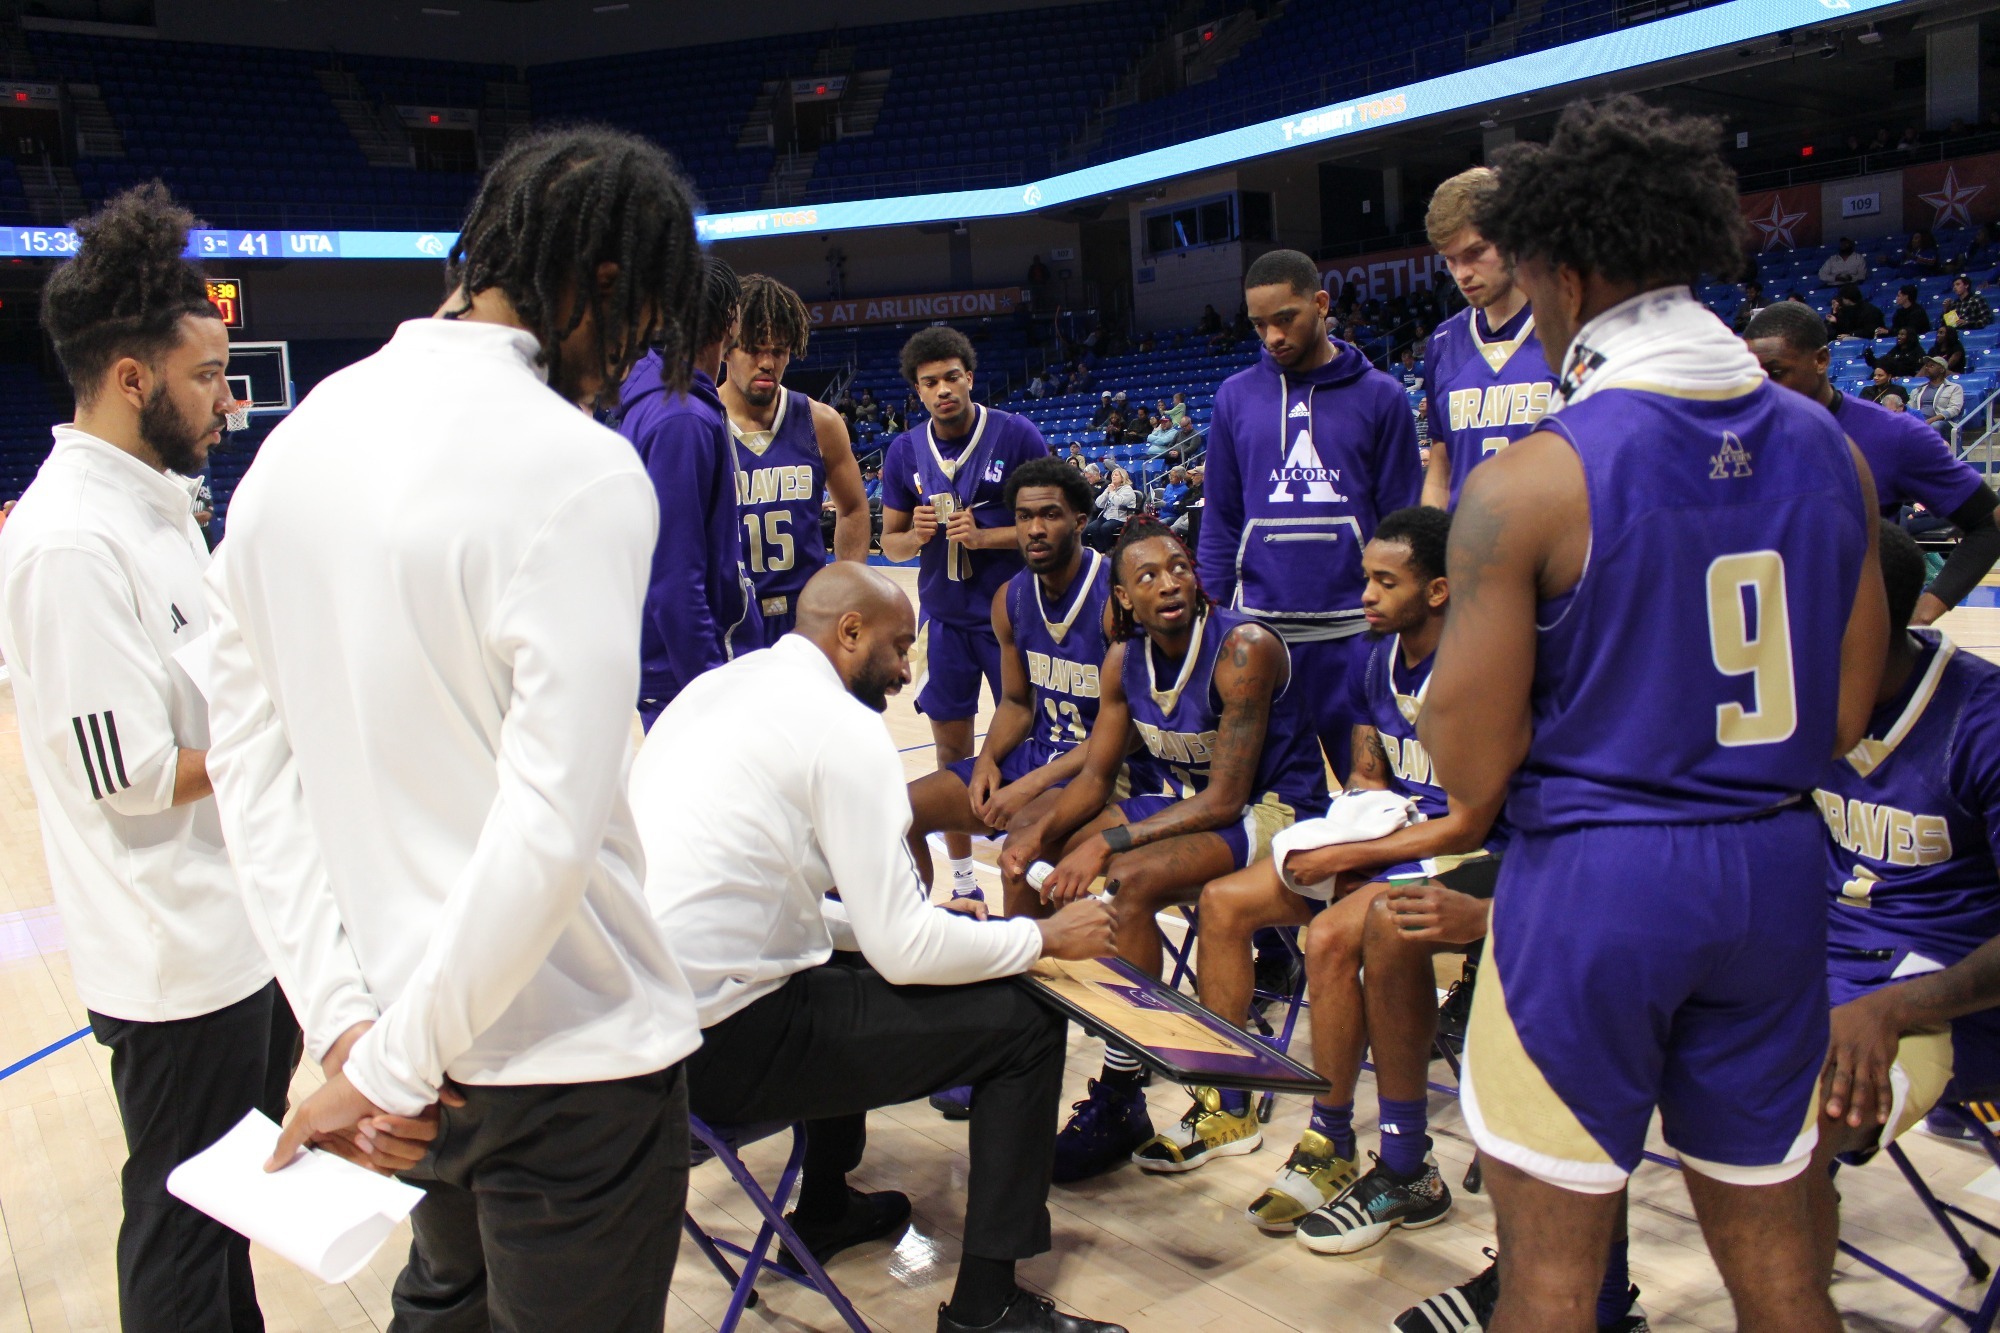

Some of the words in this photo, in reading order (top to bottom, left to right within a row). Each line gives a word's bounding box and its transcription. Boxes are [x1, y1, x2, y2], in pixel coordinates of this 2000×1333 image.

[1357, 94, 1407, 122] TOSS
[770, 209, 818, 228] TOSS
[1850, 198, 1872, 211] 109
[20, 231, 82, 251] 15:38
[203, 236, 216, 252] 3
[238, 233, 268, 256] 41
[290, 234, 333, 252] UTA
[831, 303, 857, 322] AT
[865, 293, 996, 320] ARLINGTON
[1449, 382, 1552, 431] BRAVES
[734, 465, 813, 506] RAVES
[1269, 468, 1341, 482] ALCORN
[743, 509, 795, 573] 15
[1705, 549, 1798, 748] 9
[1026, 649, 1100, 698] BRAVES
